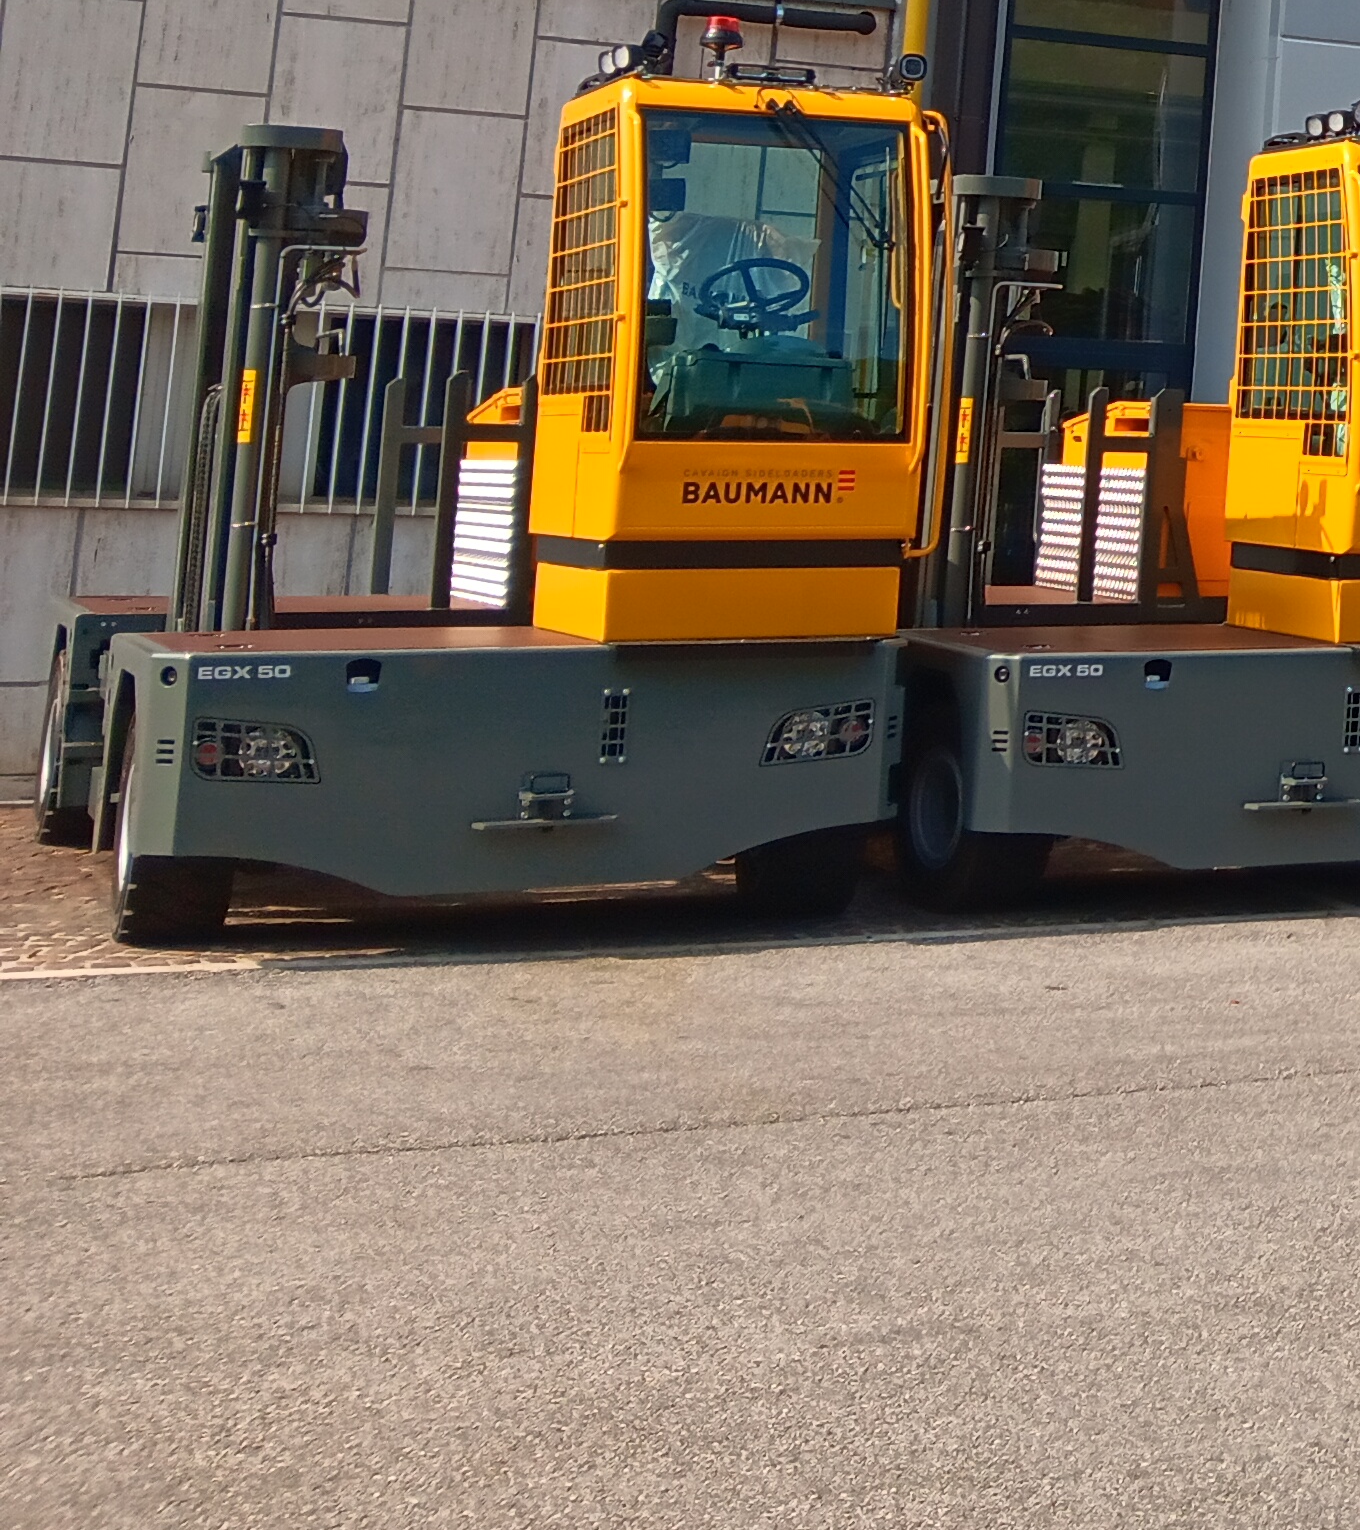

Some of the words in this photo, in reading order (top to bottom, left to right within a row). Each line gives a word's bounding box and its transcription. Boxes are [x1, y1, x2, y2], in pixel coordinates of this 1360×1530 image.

[745, 469, 833, 478] SIDELOADERS
[682, 481, 833, 504] BAUMANN
[197, 665, 252, 680] EGX
[257, 664, 291, 679] 50
[1029, 664, 1072, 677] EGX
